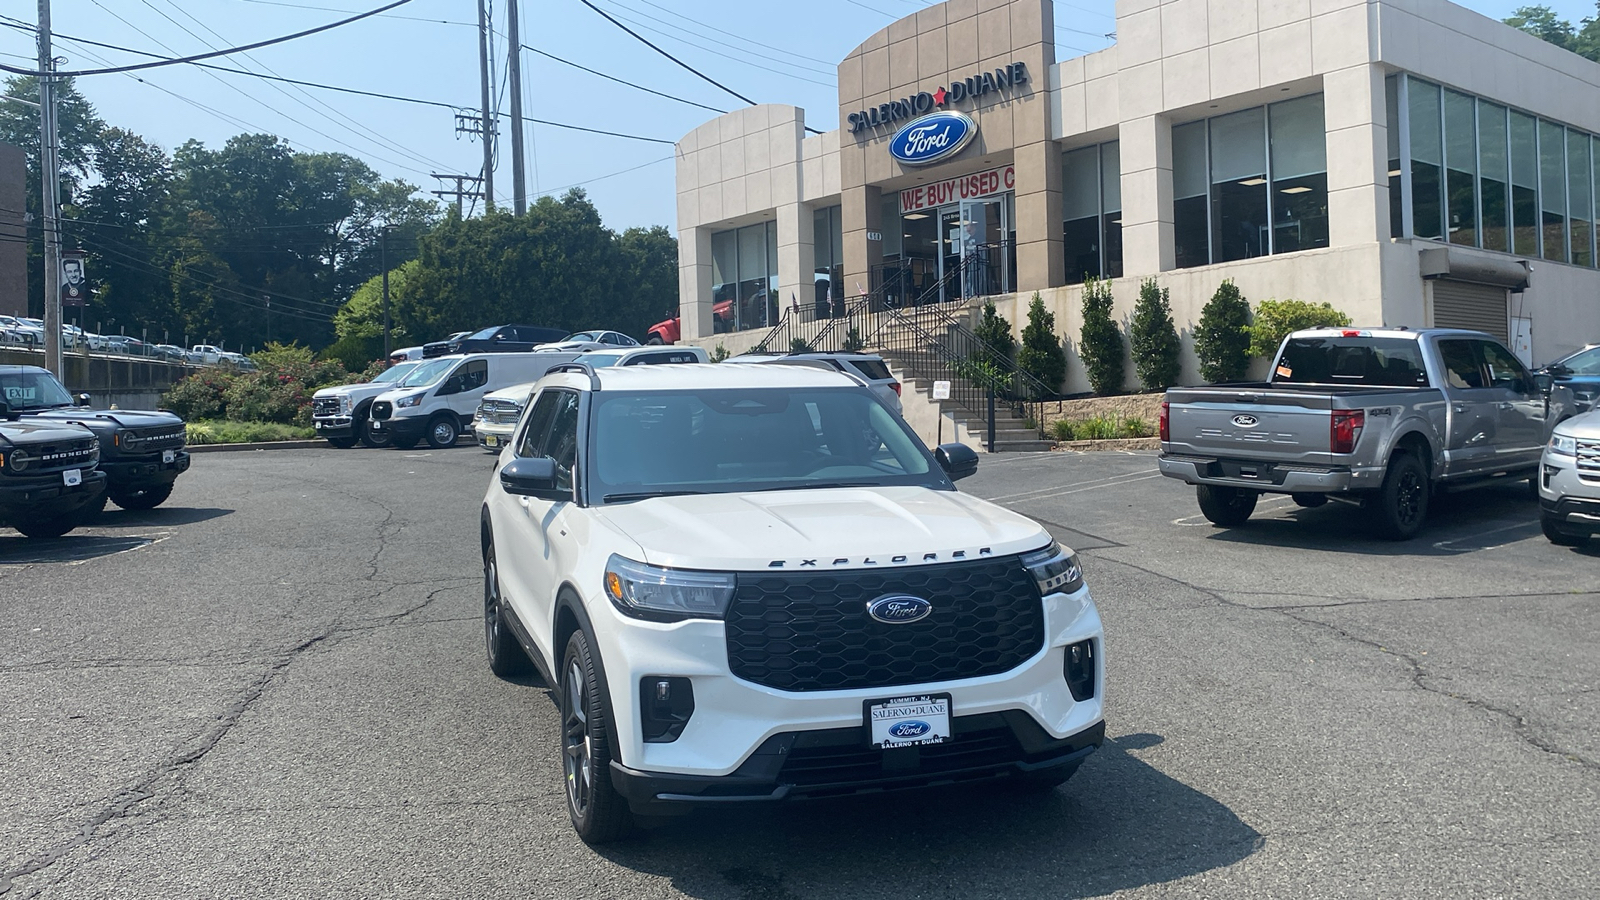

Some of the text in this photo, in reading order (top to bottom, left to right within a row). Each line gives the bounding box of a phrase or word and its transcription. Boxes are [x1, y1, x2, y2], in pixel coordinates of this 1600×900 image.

[847, 61, 1027, 133] SALERNO DUANE
[904, 123, 950, 156] Ford
[902, 188, 923, 211] WE
[927, 180, 955, 206] BUY
[960, 171, 999, 199] USED
[9, 388, 31, 398] EXIT
[1236, 415, 1254, 426] Ford
[146, 433, 180, 441] BRONCO
[42, 449, 89, 460] BRONCO
[768, 547, 991, 568] EXPLORER
[885, 601, 918, 618] Ford
[872, 704, 946, 718] SALERNO DUANE
[896, 723, 923, 736] Ford
[880, 741, 912, 749] SALERNO
